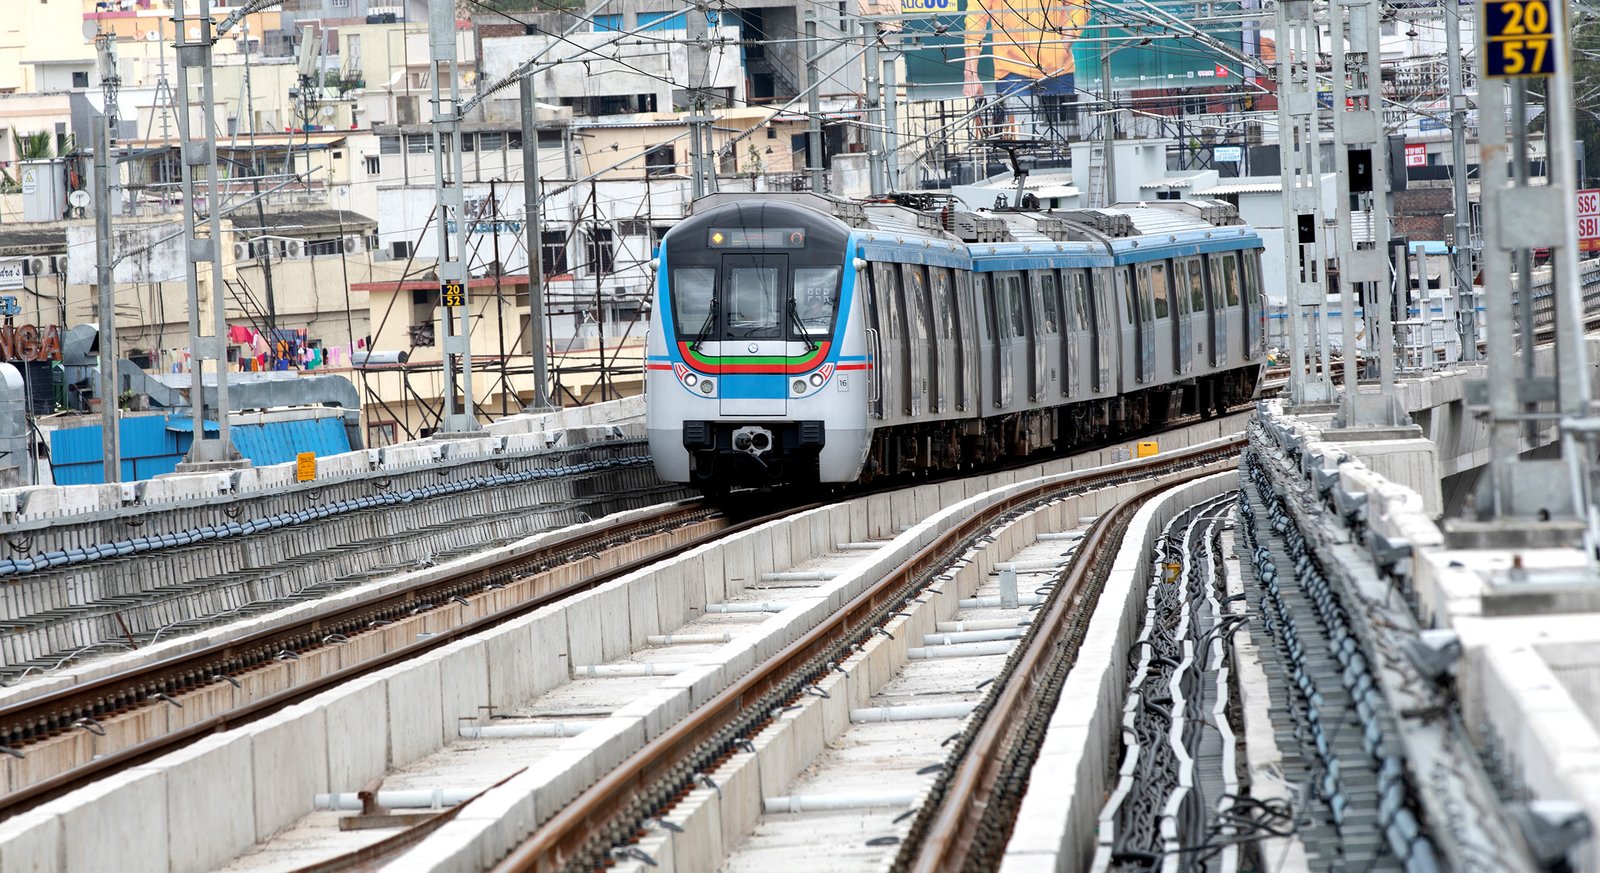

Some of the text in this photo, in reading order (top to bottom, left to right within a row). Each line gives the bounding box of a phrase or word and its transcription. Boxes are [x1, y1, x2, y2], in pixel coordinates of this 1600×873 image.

[1501, 1, 1548, 34] 20
[1503, 41, 1548, 74] 57
[1578, 195, 1597, 213] SSC
[1578, 218, 1598, 236] SBI
[446, 284, 460, 295] 20
[447, 296, 460, 306] 52
